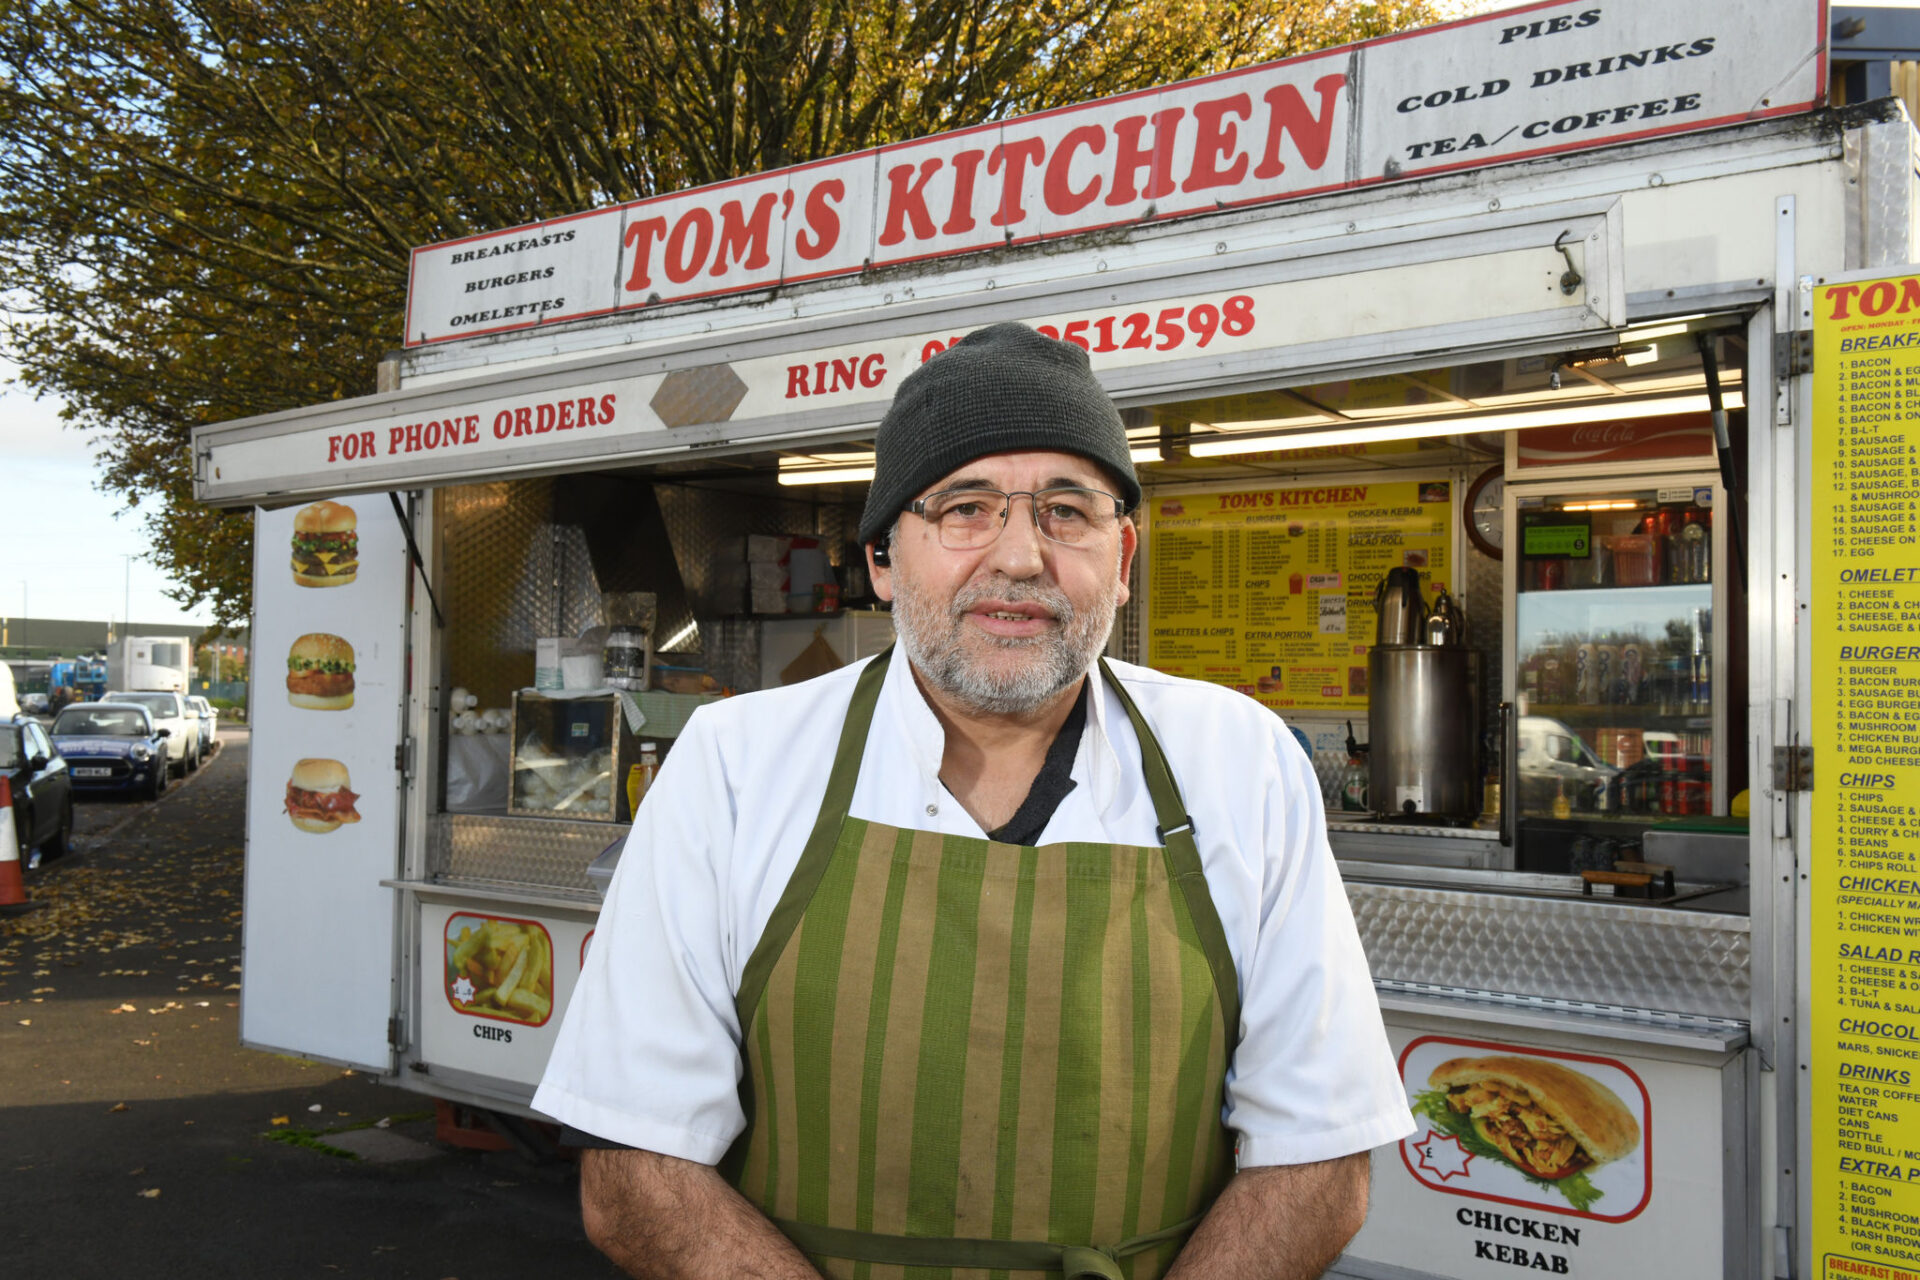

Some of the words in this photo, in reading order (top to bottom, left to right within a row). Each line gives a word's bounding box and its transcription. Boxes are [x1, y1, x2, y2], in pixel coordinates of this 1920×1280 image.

[1499, 9, 1601, 44] PIES
[1397, 79, 1510, 113] COLD
[1530, 38, 1715, 88] DRINKS
[1406, 93, 1701, 160] TEA/COFFEE
[624, 179, 844, 291] TOM'S
[878, 73, 1347, 246] KITCHEN
[451, 230, 576, 265] BREAKFASTS
[465, 267, 554, 294] BURGERS
[450, 297, 565, 327] OMELETTES
[1868, 320, 1904, 329] MONDAY
[1841, 332, 1920, 352] BREAKF
[1851, 358, 1891, 368] BACON
[786, 353, 887, 399] RING
[1851, 369, 1890, 379] BACON
[1851, 380, 1890, 390] BACON
[1851, 392, 1890, 401] BACON
[1851, 403, 1890, 412] BACON
[1851, 414, 1890, 423] BACON
[328, 431, 376, 462] FOR
[388, 414, 479, 455] PHONE
[493, 394, 616, 440] ORDERS
[1851, 425, 1879, 434] B-L-T
[1851, 435, 1905, 445] SAUSAGE
[1851, 446, 1905, 457] SAUSAGE
[1851, 457, 1905, 468] SAUSAGE
[1851, 469, 1907, 479] SAUSAGE,
[1851, 480, 1908, 490] SAUSAGE,
[1218, 492, 1274, 509] TOM'S
[1280, 487, 1368, 506] KITCHEN
[1851, 493, 1857, 501] &
[1348, 509, 1388, 518] CHICKEN
[1391, 506, 1422, 516] KEBAB
[1851, 502, 1905, 512] SAUSAGE
[1909, 502, 1916, 510] &
[1246, 514, 1286, 524] BURGERS
[1851, 514, 1905, 523] SAUSAGE
[1909, 513, 1916, 521] &
[1851, 525, 1905, 534] SAUSAGE
[1348, 537, 1378, 547] SALAD
[1380, 535, 1404, 545] ROLL
[1851, 536, 1895, 545] CHEESE
[1899, 536, 1915, 544] ON
[1851, 548, 1874, 557] EGG
[1245, 580, 1270, 589] CHIPS
[1849, 590, 1894, 598] CHEESE
[1849, 601, 1889, 609] BACON
[1893, 601, 1900, 609] &
[1849, 612, 1897, 621] CHEESE,
[1154, 628, 1200, 636] OMELETTES
[1849, 624, 1903, 632] SAUSAGE
[1245, 631, 1272, 639] EXTRA
[1275, 631, 1312, 639] PORTION
[1849, 666, 1897, 675] BURGER
[1849, 678, 1889, 686] BACON
[1849, 689, 1904, 697] SAUSAGE
[1849, 700, 1873, 708] EGG
[1877, 701, 1920, 709] BURGE
[1849, 711, 1889, 720] BACON
[1893, 712, 1900, 720] &
[1849, 722, 1916, 731] MUSHROOM
[1849, 734, 1899, 742] CHICKEN
[1849, 745, 1882, 753] MEGA
[1885, 745, 1920, 755] BURG
[1849, 756, 1872, 764] ADD
[1840, 773, 1896, 788] CHIPS
[1850, 793, 1883, 802] CHIPS
[1850, 804, 1904, 814] SAUSAGE
[1908, 807, 1915, 815] &
[1850, 815, 1895, 825] CHEESE
[1899, 818, 1906, 826] &
[1850, 827, 1888, 836] CURRY
[1892, 829, 1899, 837] &
[1850, 838, 1888, 848] BEANS
[1850, 849, 1904, 860] SAUSAGE
[1908, 853, 1915, 861] &
[1850, 860, 1883, 870] CHIPS
[1887, 862, 1917, 873] ROLL
[1837, 895, 1904, 908] (SPECIALLY
[1850, 912, 1900, 924] CHICKEN
[1850, 923, 1900, 935] CHICKEN
[1839, 944, 1903, 961] SALAD
[1850, 965, 1895, 977] CHEESE
[1899, 970, 1906, 978] &
[1850, 976, 1895, 988] CHEESE
[1899, 982, 1906, 990] &
[1850, 987, 1879, 998] B-L-T
[1850, 998, 1880, 1009] TUNA
[1884, 1003, 1891, 1011] &
[1895, 1004, 1920, 1014] SAL
[473, 1025, 512, 1043] CHIPS
[1838, 1041, 1873, 1055] MARS,
[1840, 1063, 1911, 1084] DRINKS
[1838, 1083, 1860, 1094] TEA
[1863, 1087, 1879, 1096] OR
[1838, 1095, 1877, 1107] WATER
[1839, 1106, 1863, 1116] DIET
[1867, 1110, 1898, 1122] CANS
[1839, 1117, 1869, 1129] CANS
[1839, 1129, 1883, 1143] BOTTLE
[1426, 1147, 1432, 1158] £
[1839, 1140, 1861, 1151] RED
[1865, 1144, 1894, 1157] BULL
[1840, 1157, 1901, 1179] EXTRA
[1851, 1182, 1892, 1196] BACON
[1851, 1194, 1875, 1205] EGG
[1851, 1205, 1919, 1224] MUSHROOM
[1457, 1208, 1580, 1247] CHICKEN
[1851, 1217, 1890, 1231] BLACK
[1894, 1224, 1920, 1237] PUD
[1851, 1229, 1882, 1241] HASH
[1852, 1242, 1871, 1252] (OR
[1475, 1240, 1569, 1274] KEBAB
[1830, 1258, 1890, 1278] BREAKFAST
